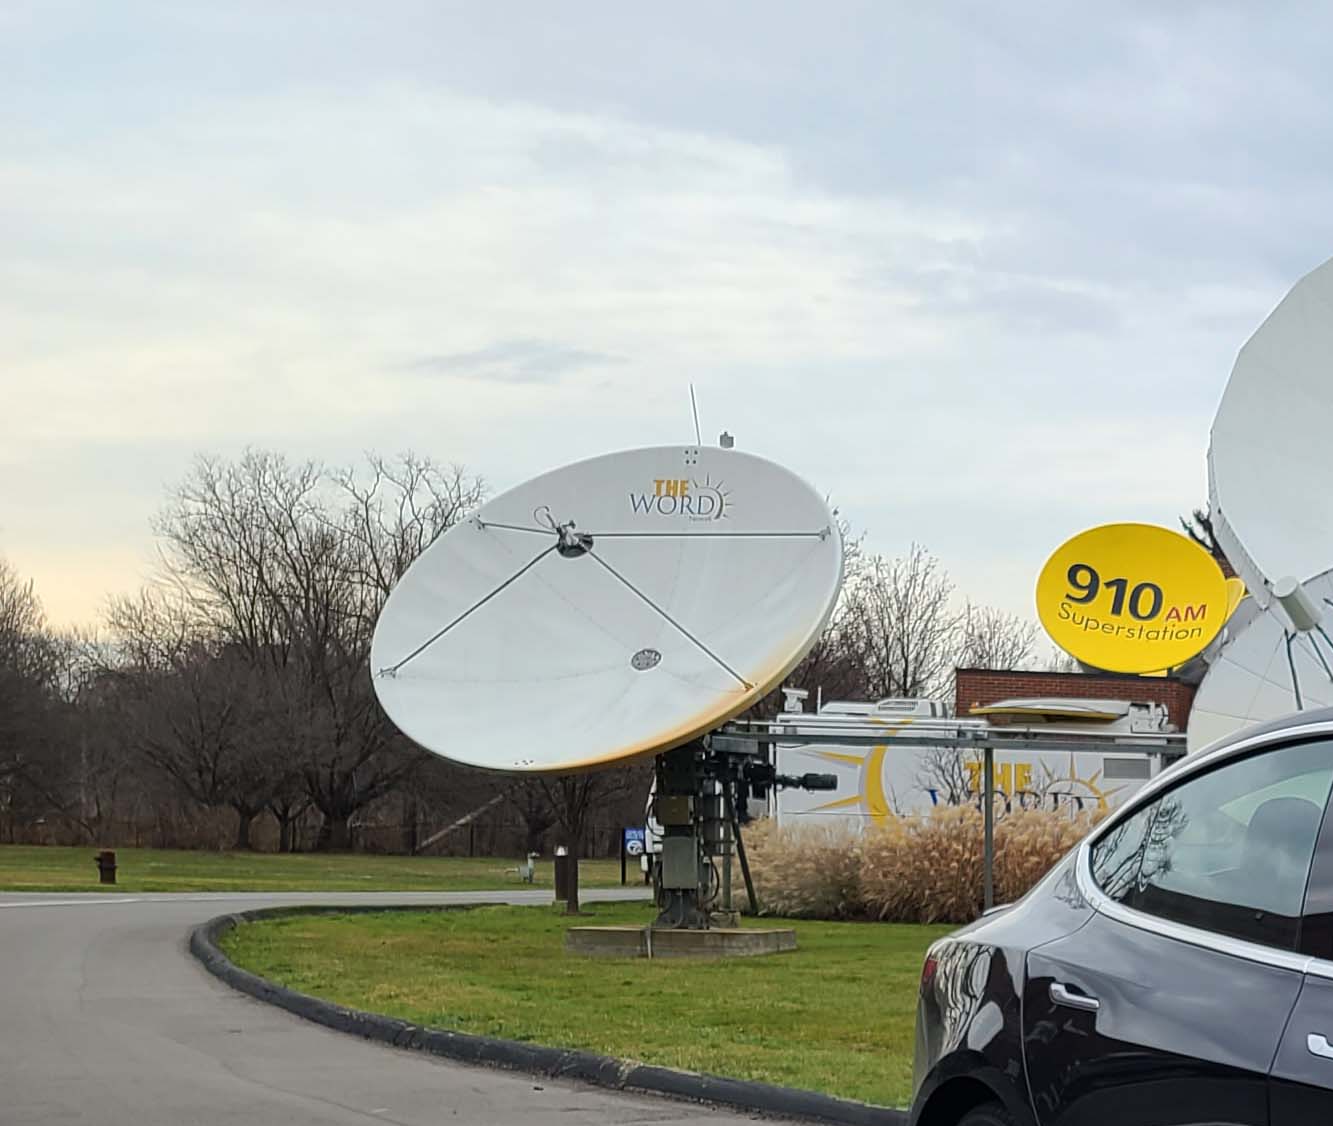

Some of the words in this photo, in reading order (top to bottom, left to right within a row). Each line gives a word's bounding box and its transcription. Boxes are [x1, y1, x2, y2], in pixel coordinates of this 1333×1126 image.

[630, 493, 715, 515] WORD
[654, 479, 688, 497] THE
[1065, 563, 1164, 621] 910
[1165, 604, 1207, 623] AM
[1058, 602, 1202, 641] Superstation
[964, 763, 1032, 795] THE
